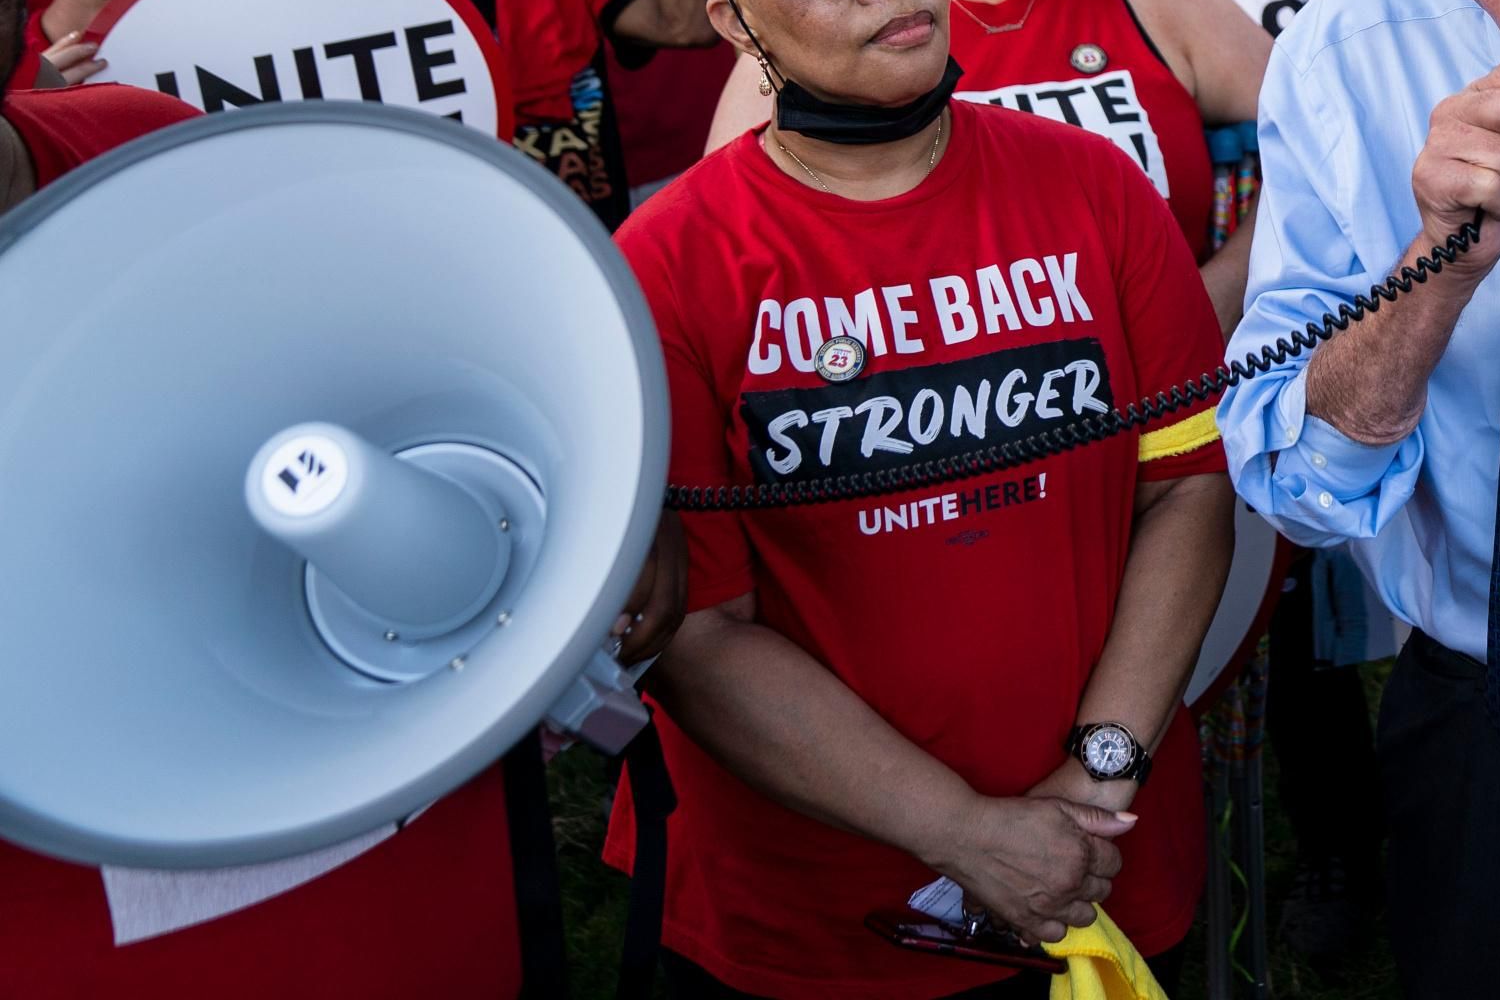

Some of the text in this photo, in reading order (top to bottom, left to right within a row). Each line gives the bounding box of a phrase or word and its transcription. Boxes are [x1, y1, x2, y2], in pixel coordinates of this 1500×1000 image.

[748, 251, 1094, 375] COME BACK
[828, 354, 849, 369] 23
[764, 359, 1110, 475] STRONGER
